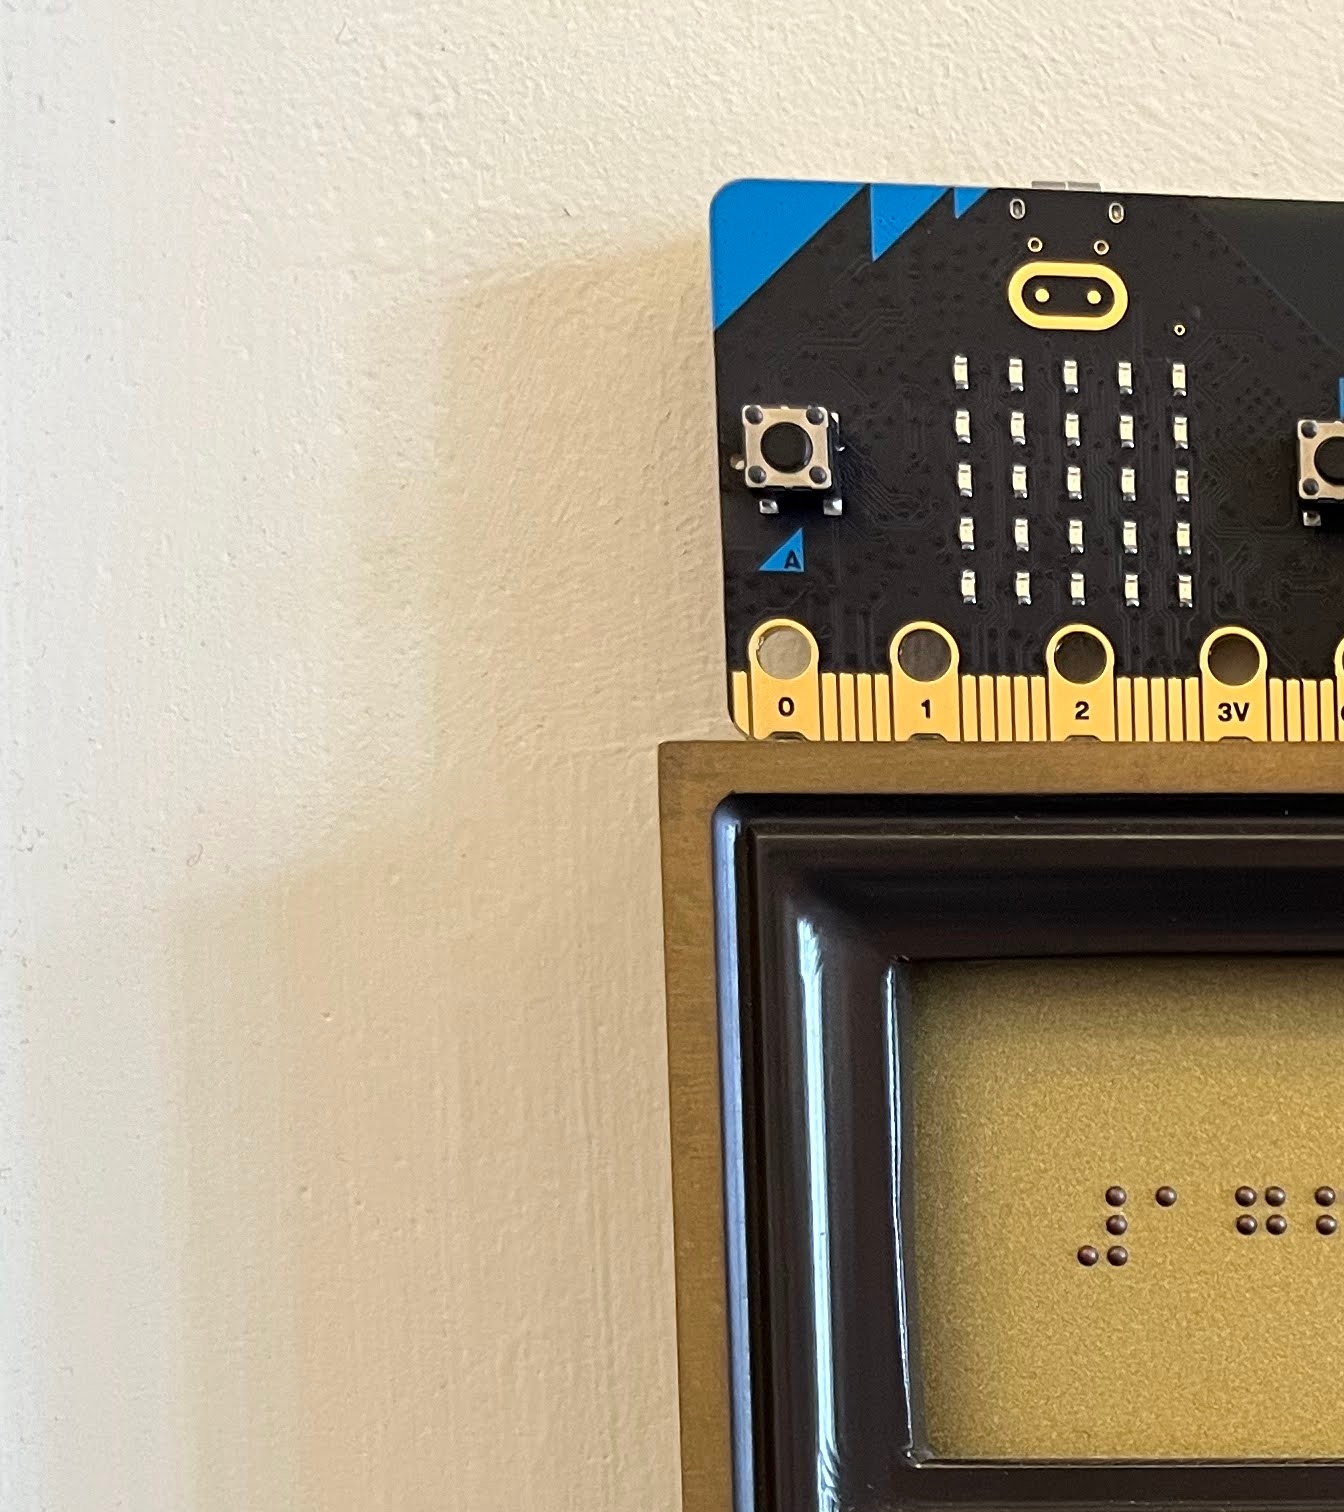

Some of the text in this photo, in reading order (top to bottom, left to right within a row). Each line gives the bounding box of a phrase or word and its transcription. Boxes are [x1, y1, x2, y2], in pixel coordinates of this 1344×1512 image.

[783, 549, 802, 570] A
[920, 699, 931, 719] 1
[1074, 700, 1090, 720] 2
[1217, 702, 1250, 722] 3V
